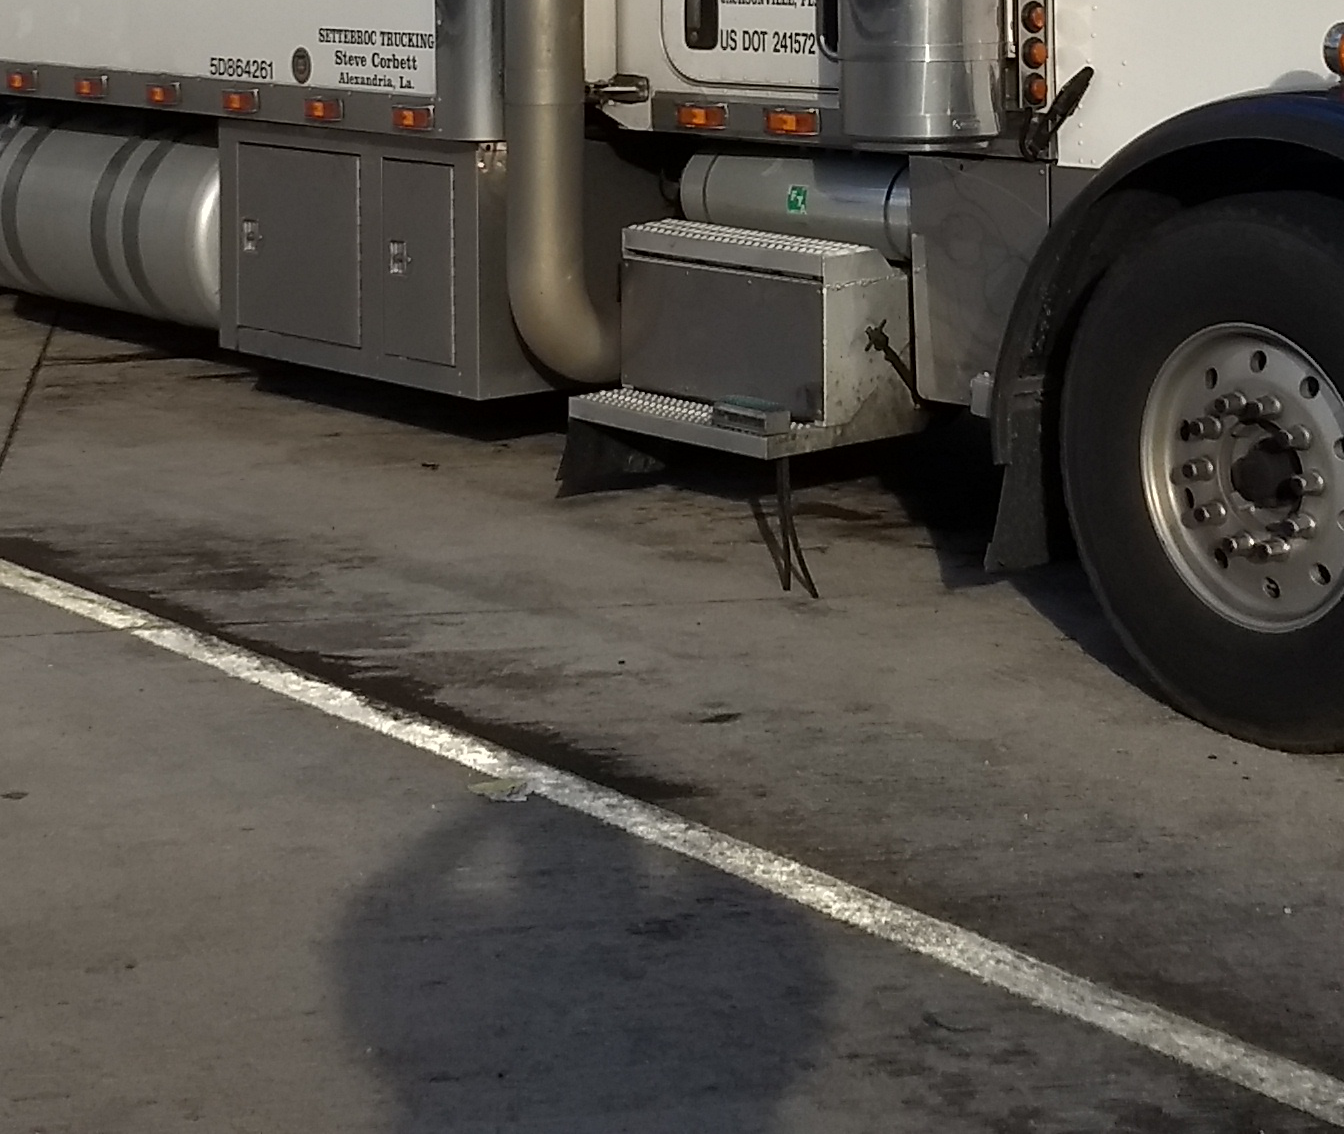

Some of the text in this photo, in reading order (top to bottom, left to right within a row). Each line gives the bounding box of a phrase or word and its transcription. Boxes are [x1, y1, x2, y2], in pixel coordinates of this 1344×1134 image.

[318, 28, 434, 49] SETTEBROC TRUCKING
[720, 29, 815, 54] US DOT 241572
[210, 57, 274, 80] 5D864261
[335, 50, 418, 71] Steve Corbett
[338, 72, 415, 90] Alexandria, La.
